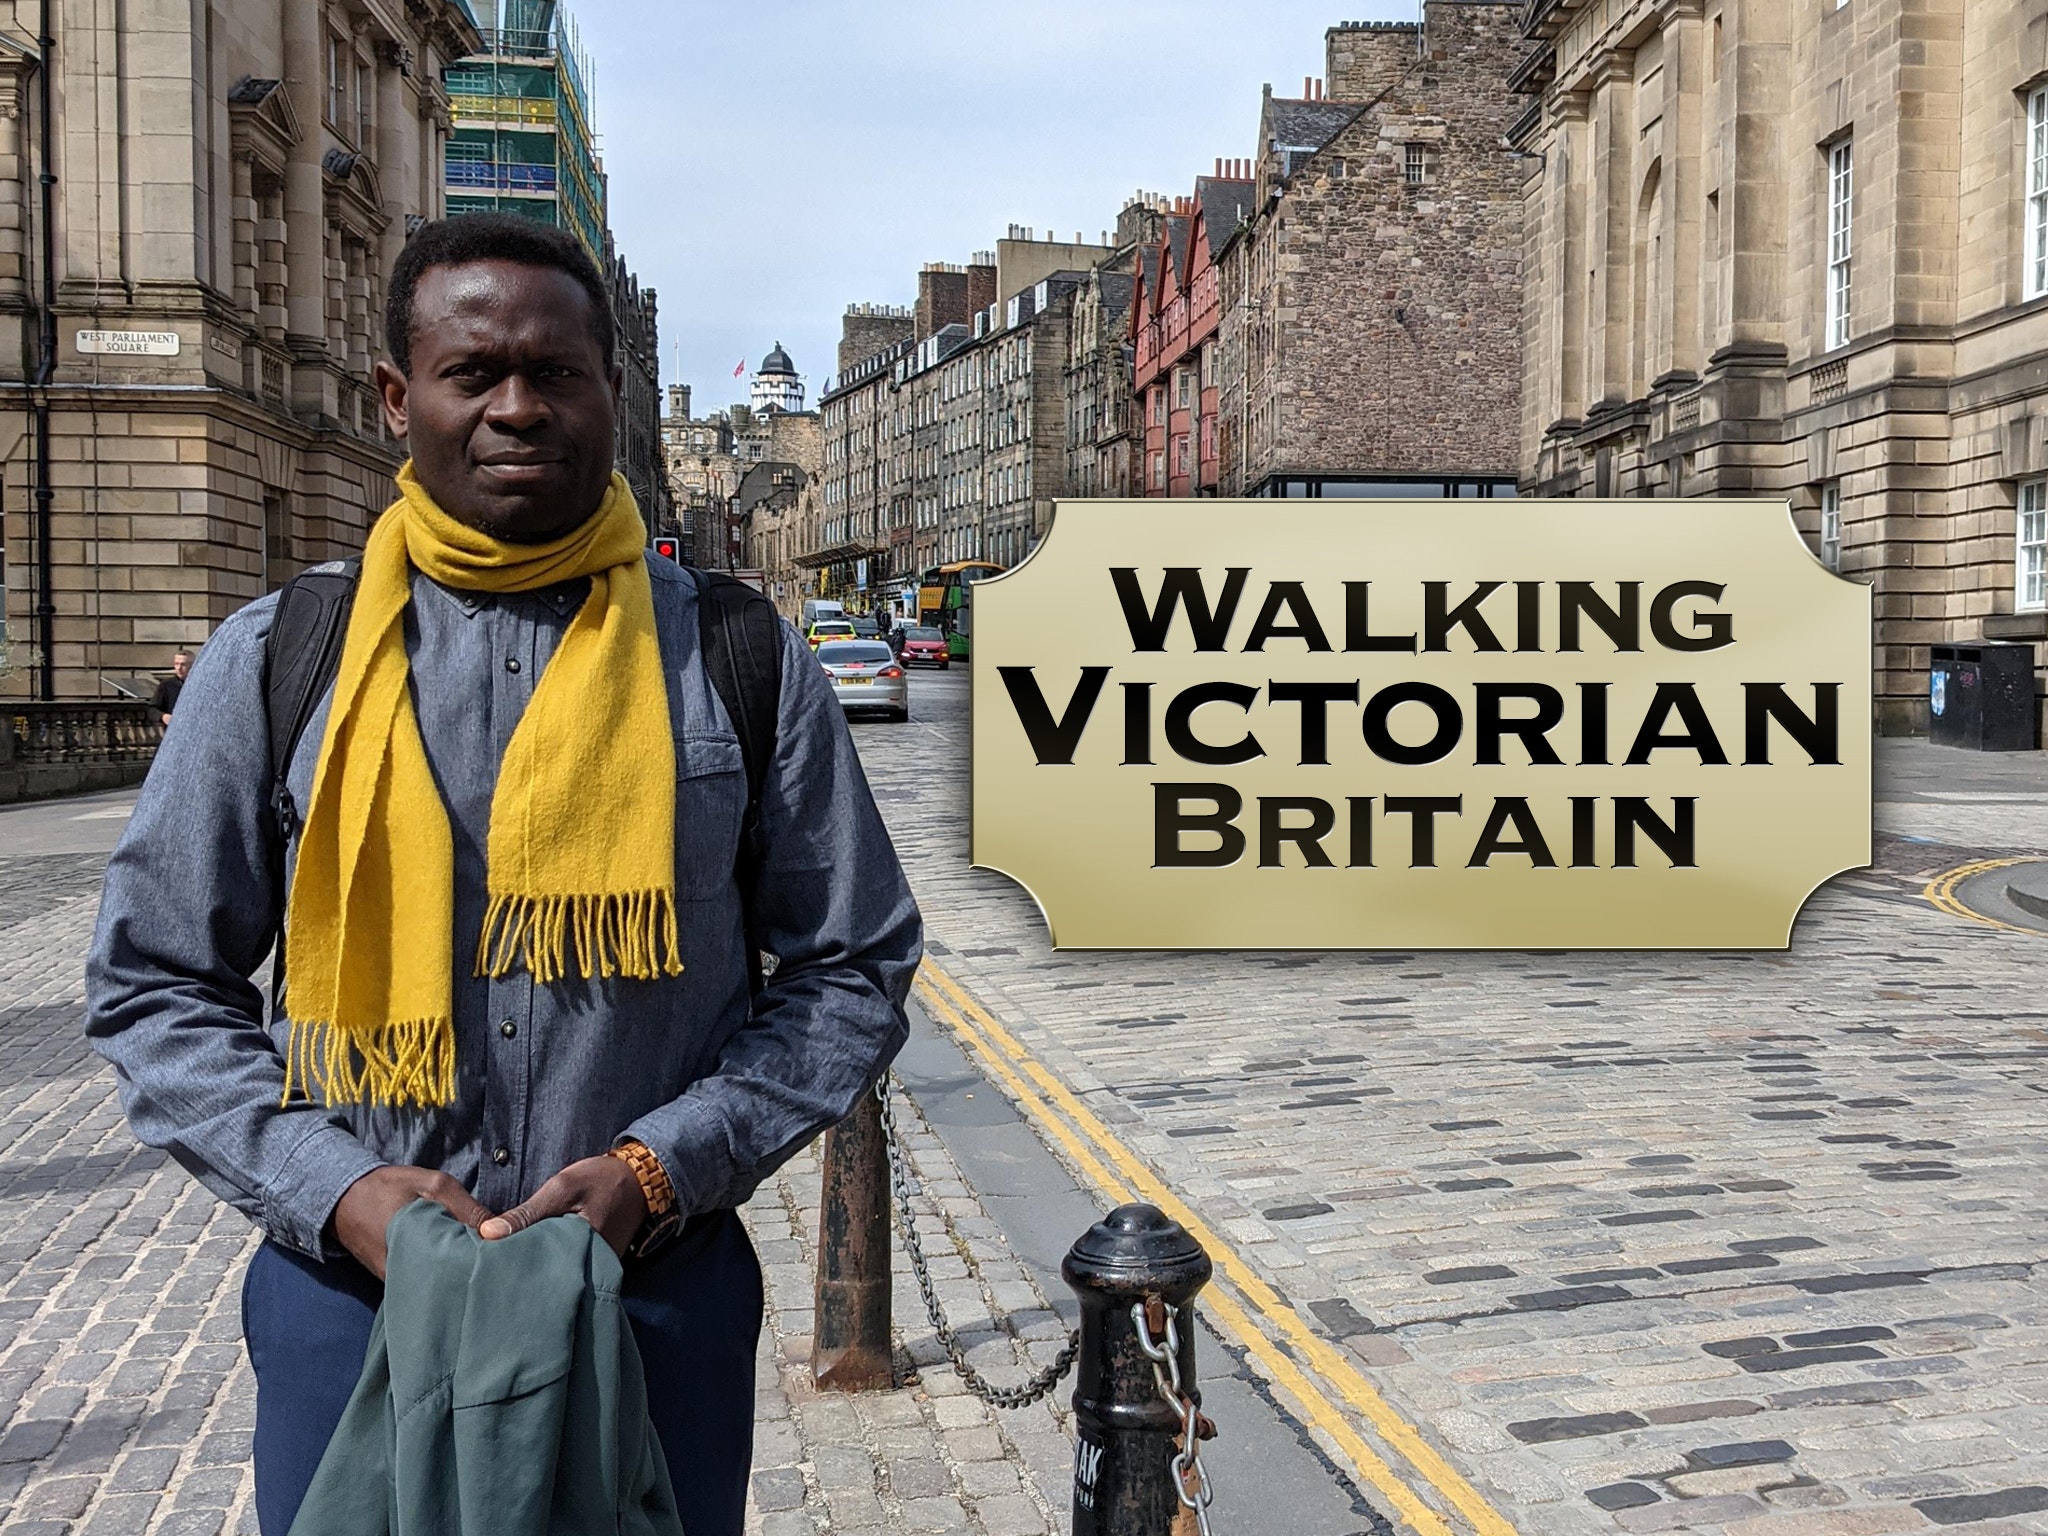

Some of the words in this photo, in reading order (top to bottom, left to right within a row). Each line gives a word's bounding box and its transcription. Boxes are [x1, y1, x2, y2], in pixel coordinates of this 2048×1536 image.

[80, 332, 106, 341] WEST
[112, 333, 175, 343] PARLIAMENT
[106, 343, 150, 352] SQUARE
